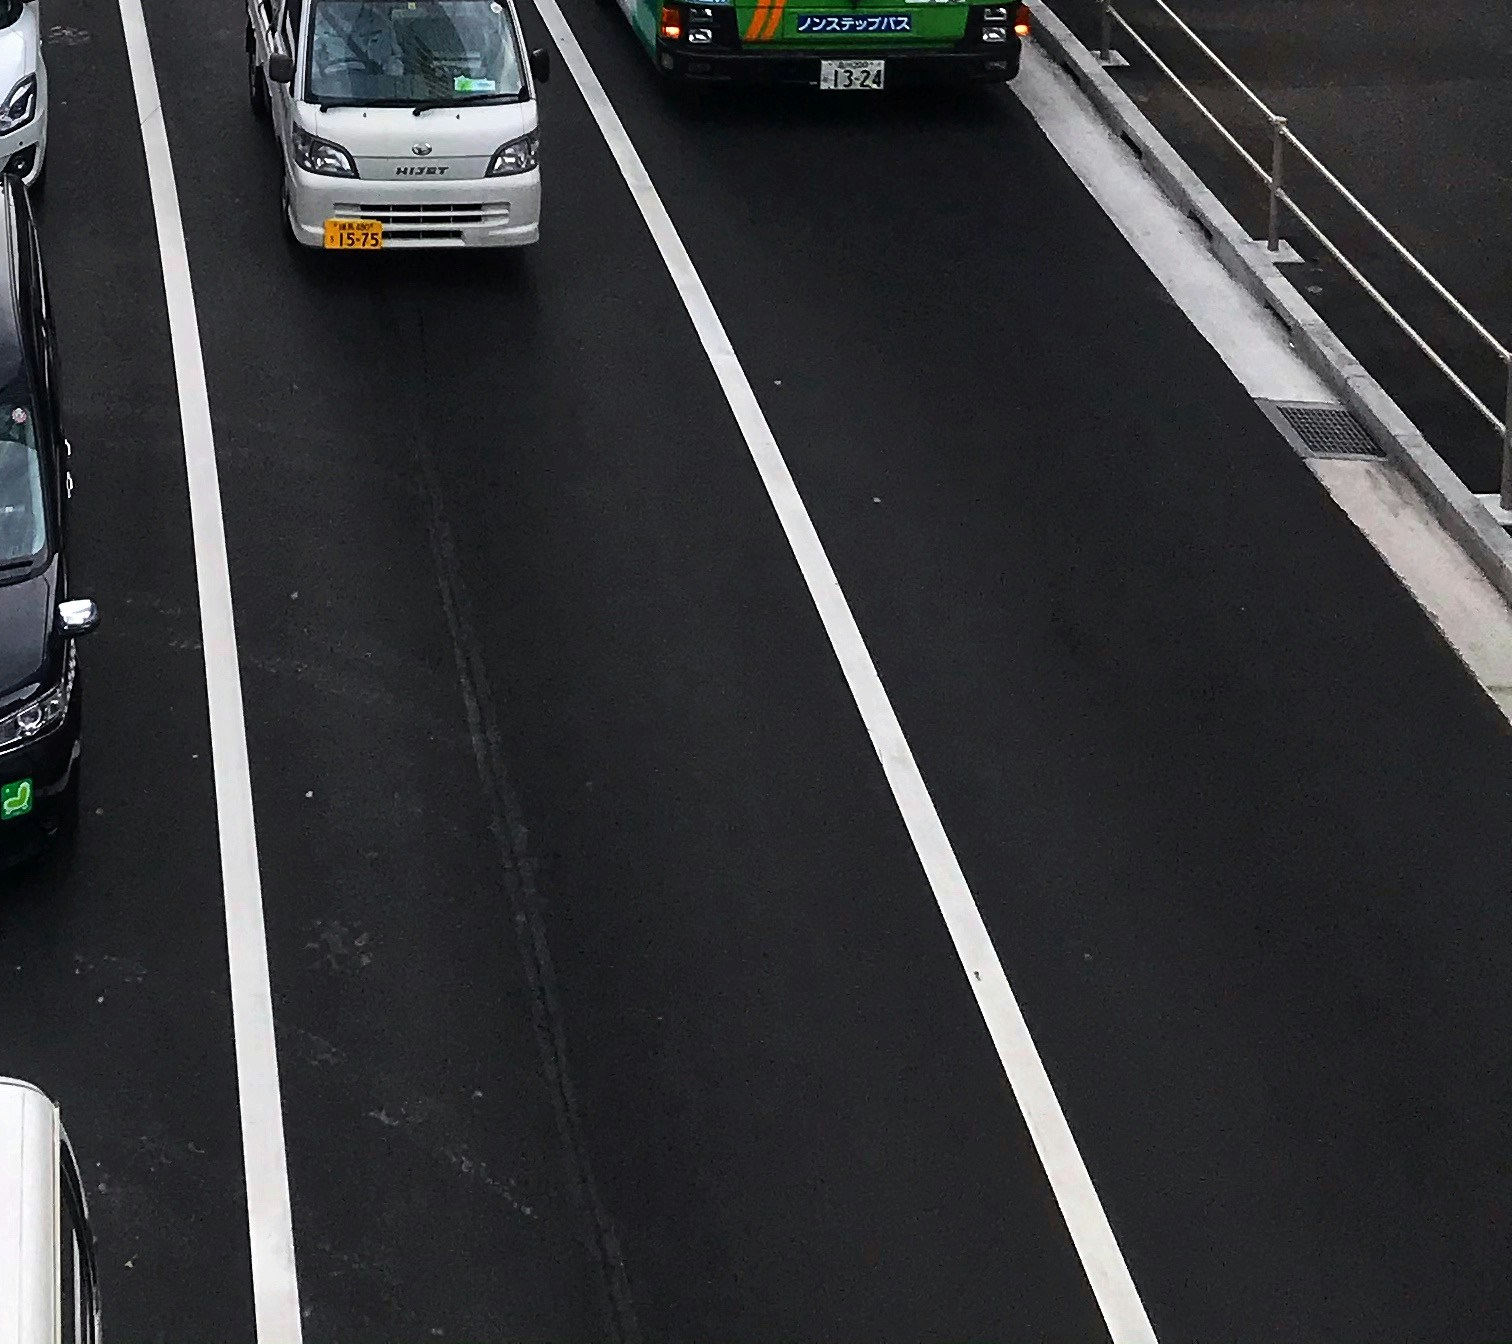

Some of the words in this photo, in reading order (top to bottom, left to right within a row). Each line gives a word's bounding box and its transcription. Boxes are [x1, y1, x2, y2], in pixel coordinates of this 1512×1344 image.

[798, 15, 911, 32] ノンステップバス
[834, 69, 882, 87] 13-24
[395, 166, 449, 176] HIJET
[340, 232, 379, 247] 15-75
